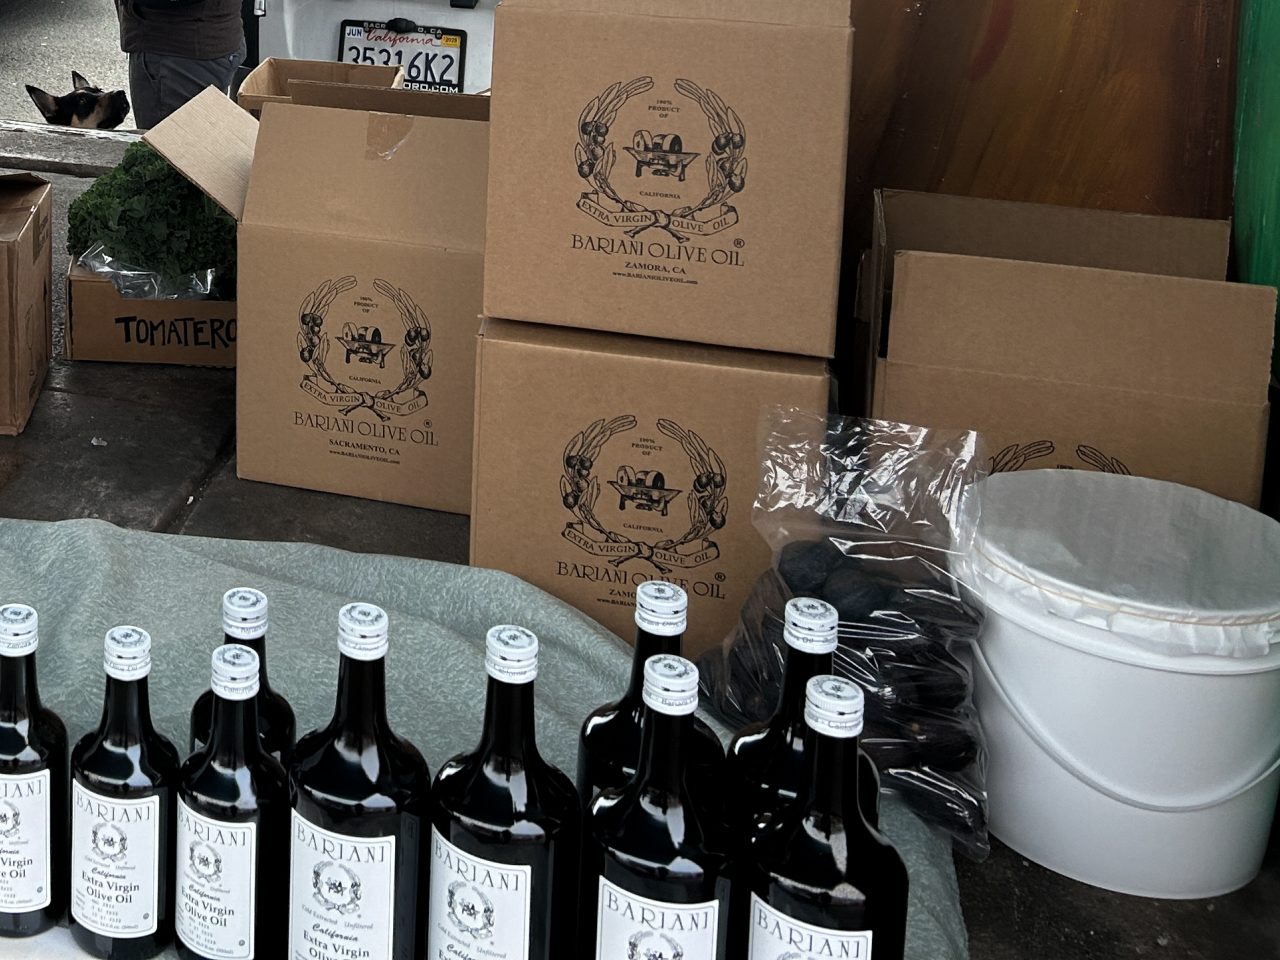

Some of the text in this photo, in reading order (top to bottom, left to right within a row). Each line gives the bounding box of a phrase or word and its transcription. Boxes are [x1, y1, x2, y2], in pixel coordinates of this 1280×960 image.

[346, 28, 362, 37] JUN
[366, 28, 441, 47] California
[430, 27, 443, 35] CA
[639, 191, 680, 199] CALIFORNIA
[582, 200, 730, 233] EXTRA VIRGIN OLIVE OIL
[571, 234, 745, 266] BARIANI OLIVE OIL
[625, 262, 687, 275] ZAMORA, CA
[349, 375, 381, 384] CALIFORNIA
[304, 382, 421, 413] EXTRA VIRGIN OLIVE OIL
[294, 411, 439, 447] BARIANI OLIVE OIL
[329, 439, 400, 456] SACRAMENTO, CA
[631, 443, 663, 452] PRODUCT
[623, 523, 663, 533] CALIFORNIA
[567, 530, 711, 565] EXTRA VIRGIN OLIVE OIL
[557, 561, 627, 585] BARIANI
[693, 581, 726, 599] OIL
[76, 791, 150, 822] BARIANI
[178, 807, 246, 846] BARIANI
[297, 824, 385, 863] BARIANI
[1, 857, 33, 868] Virgin
[10, 869, 26, 878] Oil
[91, 867, 126, 879] California
[435, 838, 519, 891] BARIANI
[82, 871, 140, 894] Extra Virgin
[189, 885, 220, 902] California
[86, 886, 132, 904] Olive Oil
[181, 885, 235, 916] Extra Virgin
[185, 902, 227, 927] Olive Oil
[608, 890, 708, 930] BARIANI
[312, 923, 358, 941] California
[758, 909, 860, 958] BARIANI
[303, 930, 370, 958] Extra Virgin
